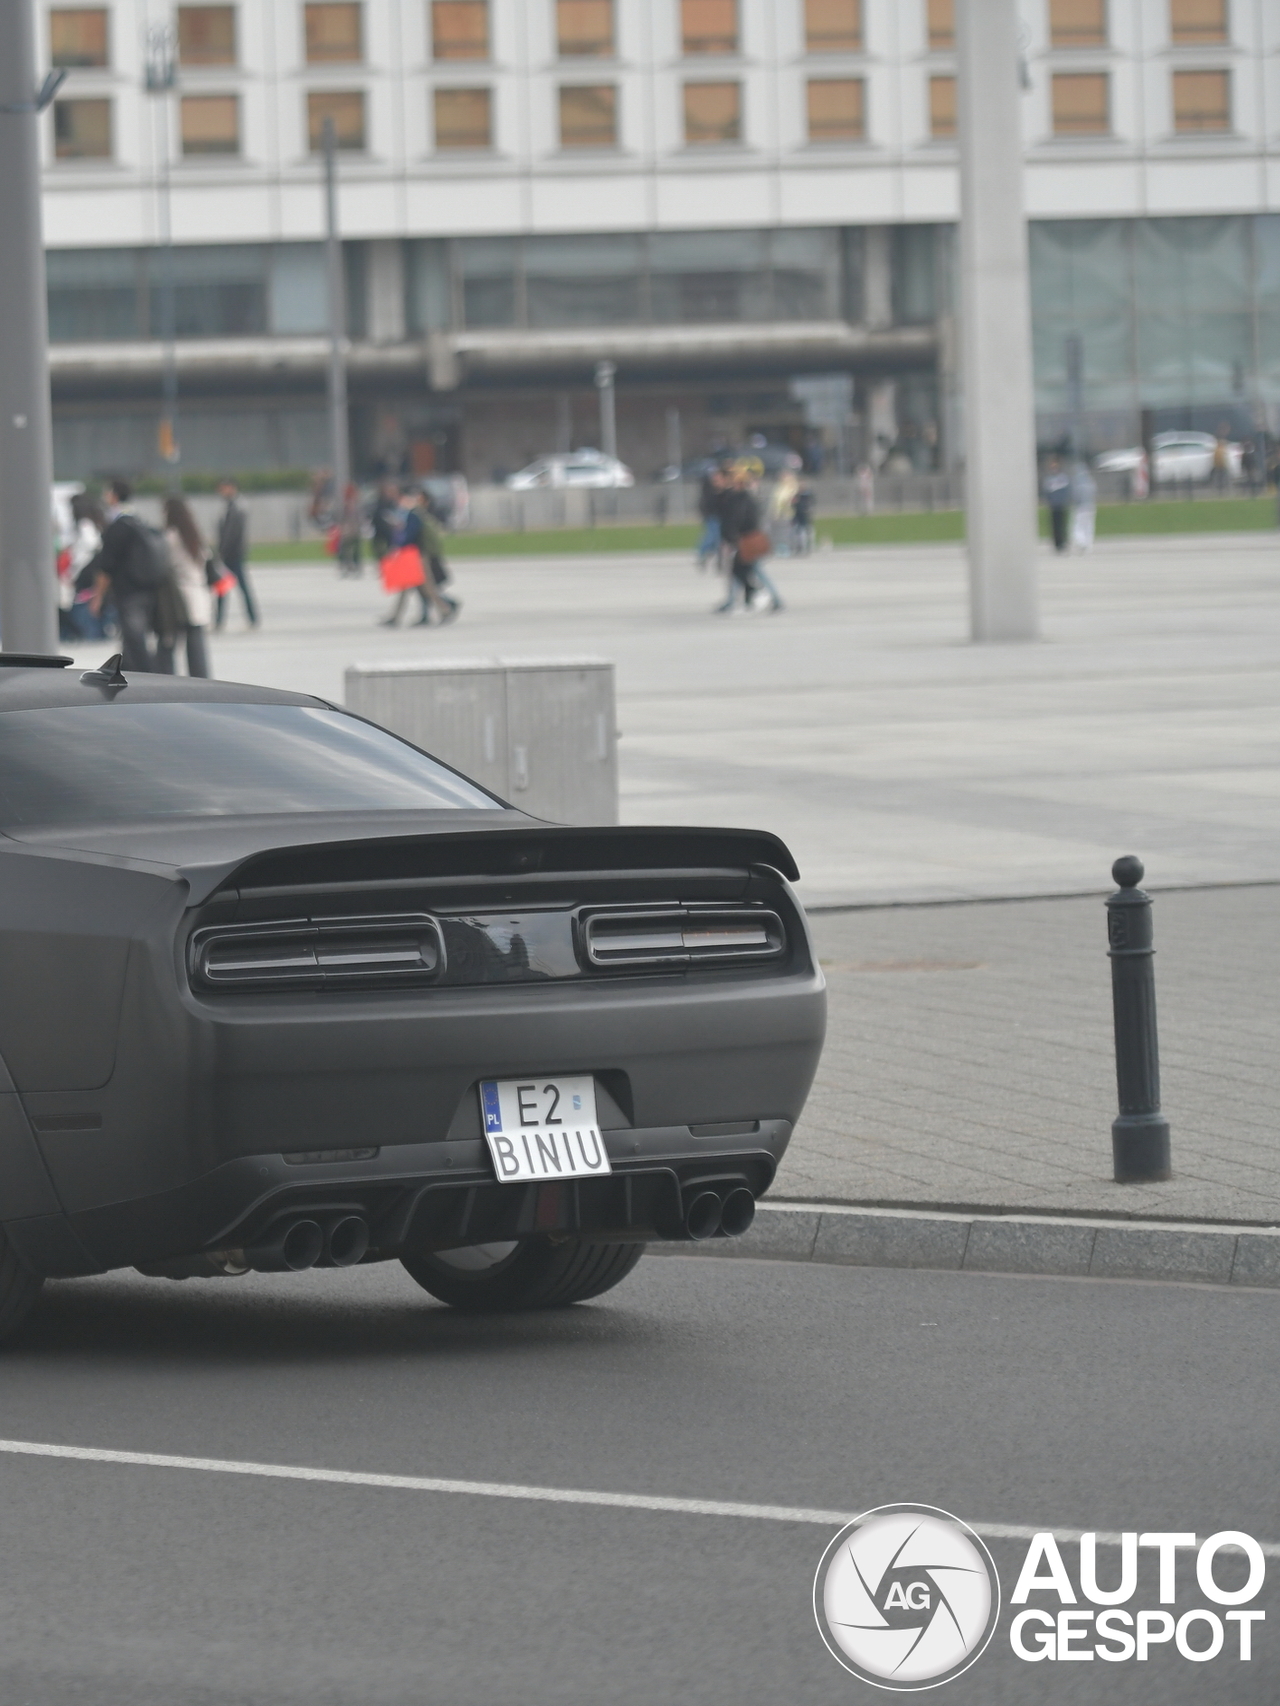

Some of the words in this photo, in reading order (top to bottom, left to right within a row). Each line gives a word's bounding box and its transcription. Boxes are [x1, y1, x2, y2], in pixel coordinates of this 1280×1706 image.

[487, 1114, 500, 1125] PL
[517, 1084, 562, 1126] E2
[493, 1130, 602, 1176] BINIU
